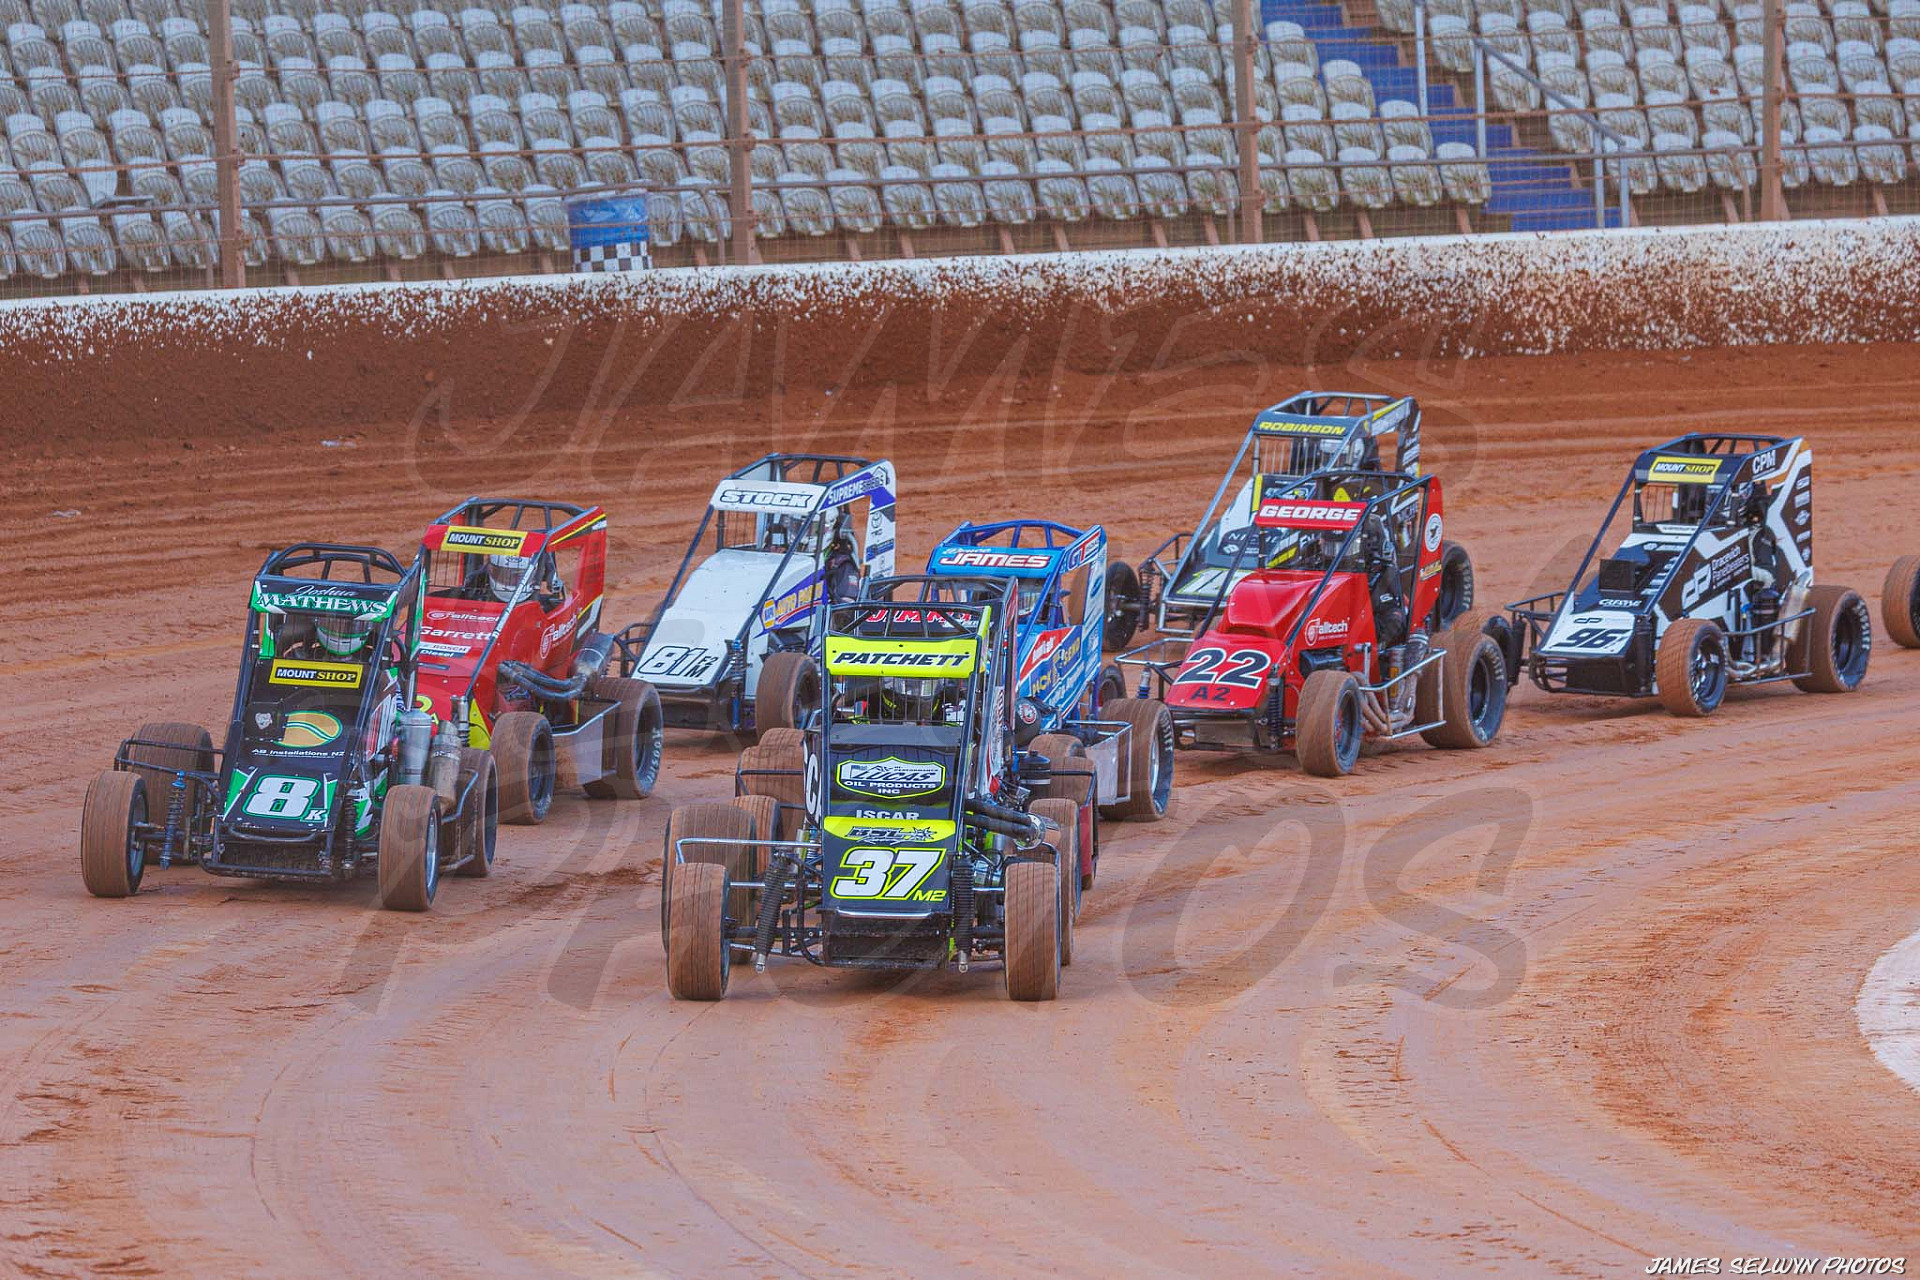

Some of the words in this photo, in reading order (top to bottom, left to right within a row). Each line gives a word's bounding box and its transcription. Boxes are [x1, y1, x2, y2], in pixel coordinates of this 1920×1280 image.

[1259, 421, 1347, 435] ROBINSON
[1654, 462, 1686, 473] MOUNT
[1685, 465, 1715, 475] SHOP
[1752, 449, 1777, 475] CPM
[720, 489, 813, 508] STOCK
[1260, 504, 1363, 521] GEORGE
[448, 533, 485, 545] MOUNT
[484, 536, 521, 548] SHOP
[939, 552, 1052, 569] JAMES
[290, 584, 359, 598] Joshua
[257, 592, 388, 614] MATHEWS
[1552, 627, 1633, 649] 96
[420, 649, 455, 658] Diesel
[638, 645, 709, 677] 81
[833, 652, 970, 667] PATCHETT
[276, 668, 317, 680] MOUNT
[316, 671, 358, 682] SHOP
[1172, 647, 1272, 689] 22
[852, 765, 937, 781] LUCAS
[243, 774, 322, 820] 8
[855, 809, 920, 820] ISCAR
[831, 847, 946, 900] 37
[912, 889, 947, 902] M2
